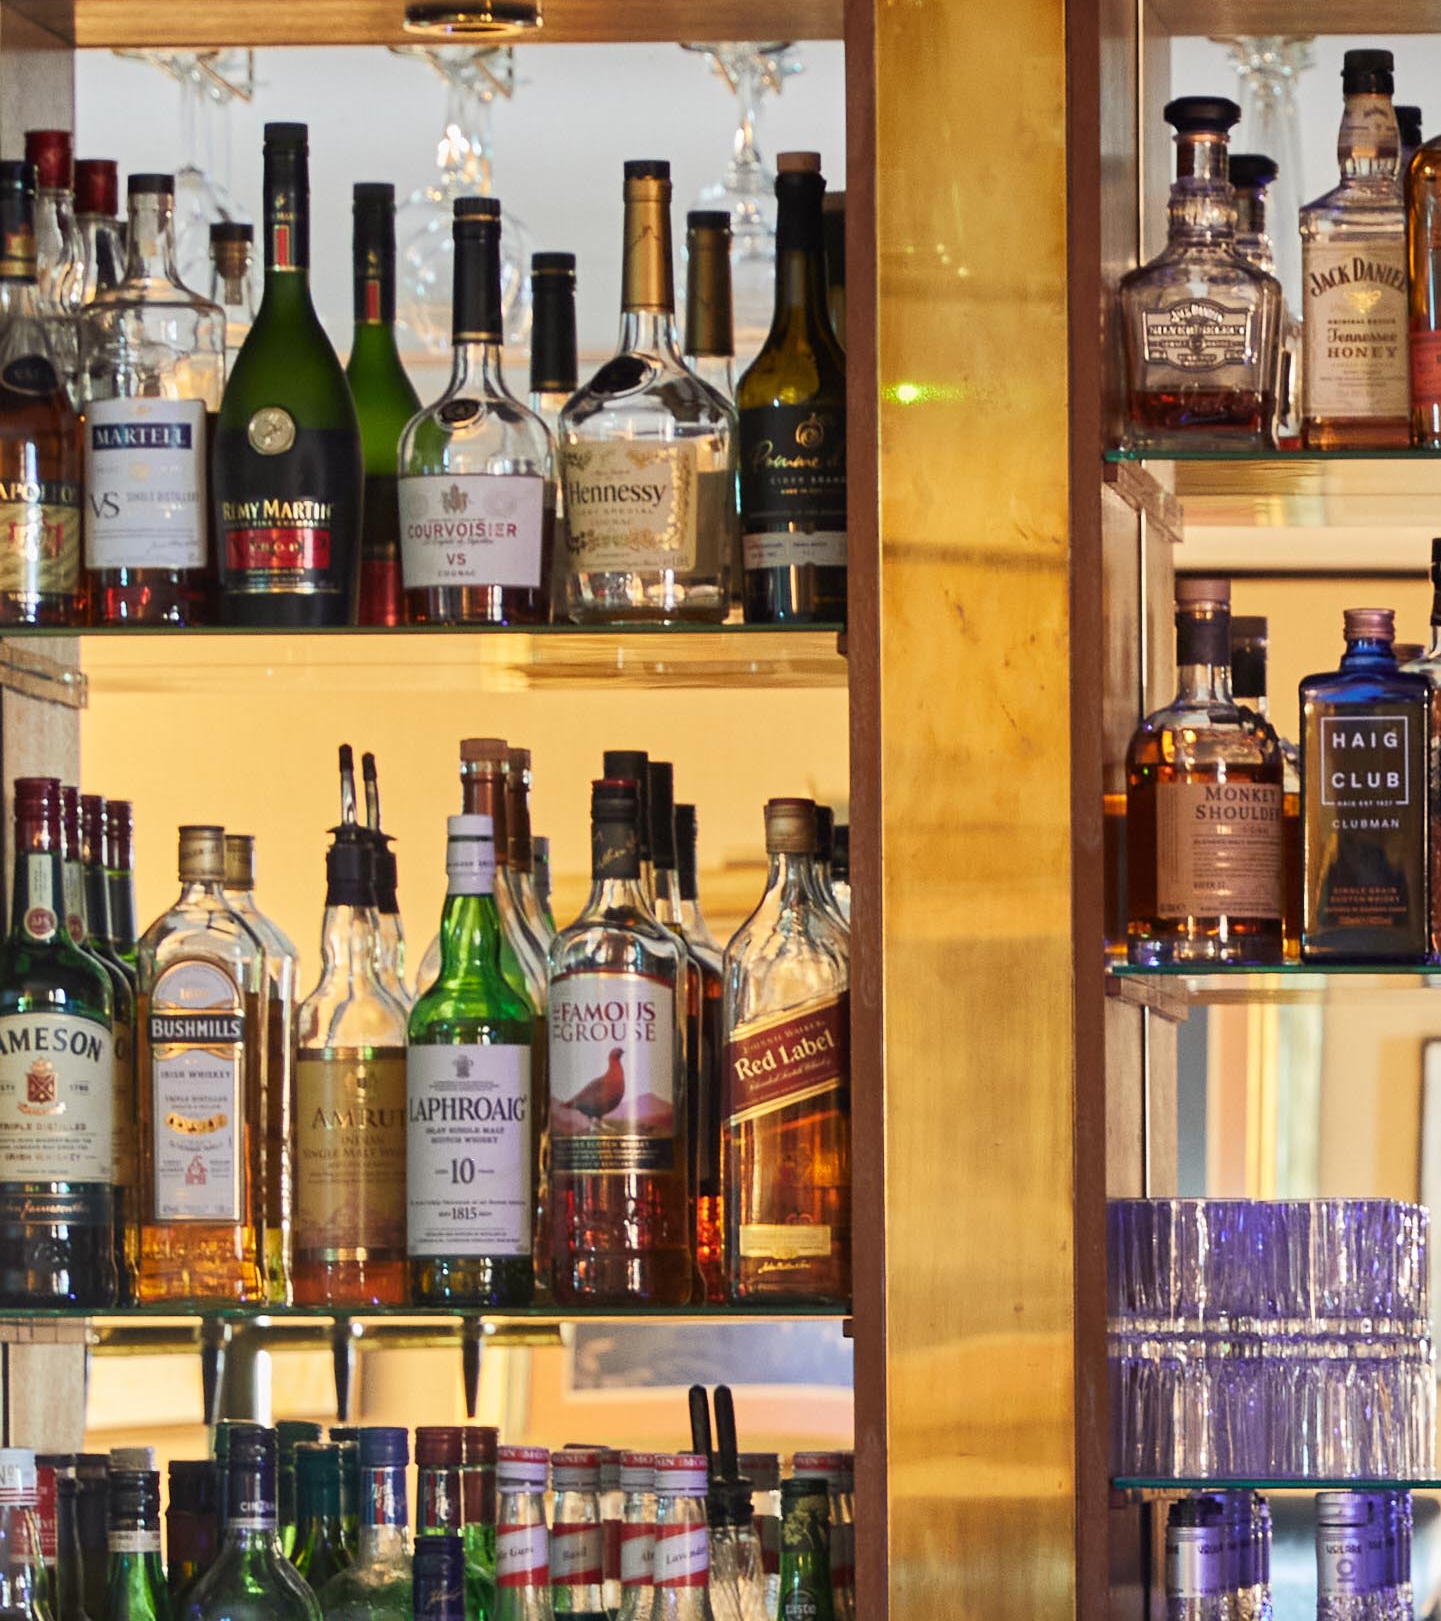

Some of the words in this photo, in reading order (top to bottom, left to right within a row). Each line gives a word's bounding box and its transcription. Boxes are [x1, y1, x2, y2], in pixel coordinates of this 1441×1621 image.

[1310, 265, 1351, 298] JACK
[1326, 327, 1398, 344] Tennessee
[1326, 346, 1398, 359] HONEY
[96, 428, 187, 446] MARTELL
[568, 481, 668, 508] Hennessy
[90, 492, 121, 519] VS
[262, 498, 333, 520] MARTIN
[407, 521, 519, 540] COURVOISIER
[445, 552, 468, 566] VS
[1331, 732, 1399, 749] HAIG
[1331, 771, 1400, 789] CLUB
[1204, 786, 1277, 803] MONKEY
[1331, 818, 1400, 830] CLUBMAN
[562, 1000, 657, 1024] FAMOUS
[151, 1018, 242, 1038] BUSHMILLS
[561, 1022, 657, 1043] GROUSE
[734, 1052, 778, 1083] Red
[779, 1028, 836, 1064] Label
[311, 1105, 408, 1130] AMRUT
[409, 1095, 526, 1122] LAPHROAIG
[450, 1157, 476, 1185] 10
[451, 1207, 478, 1221] 1815
